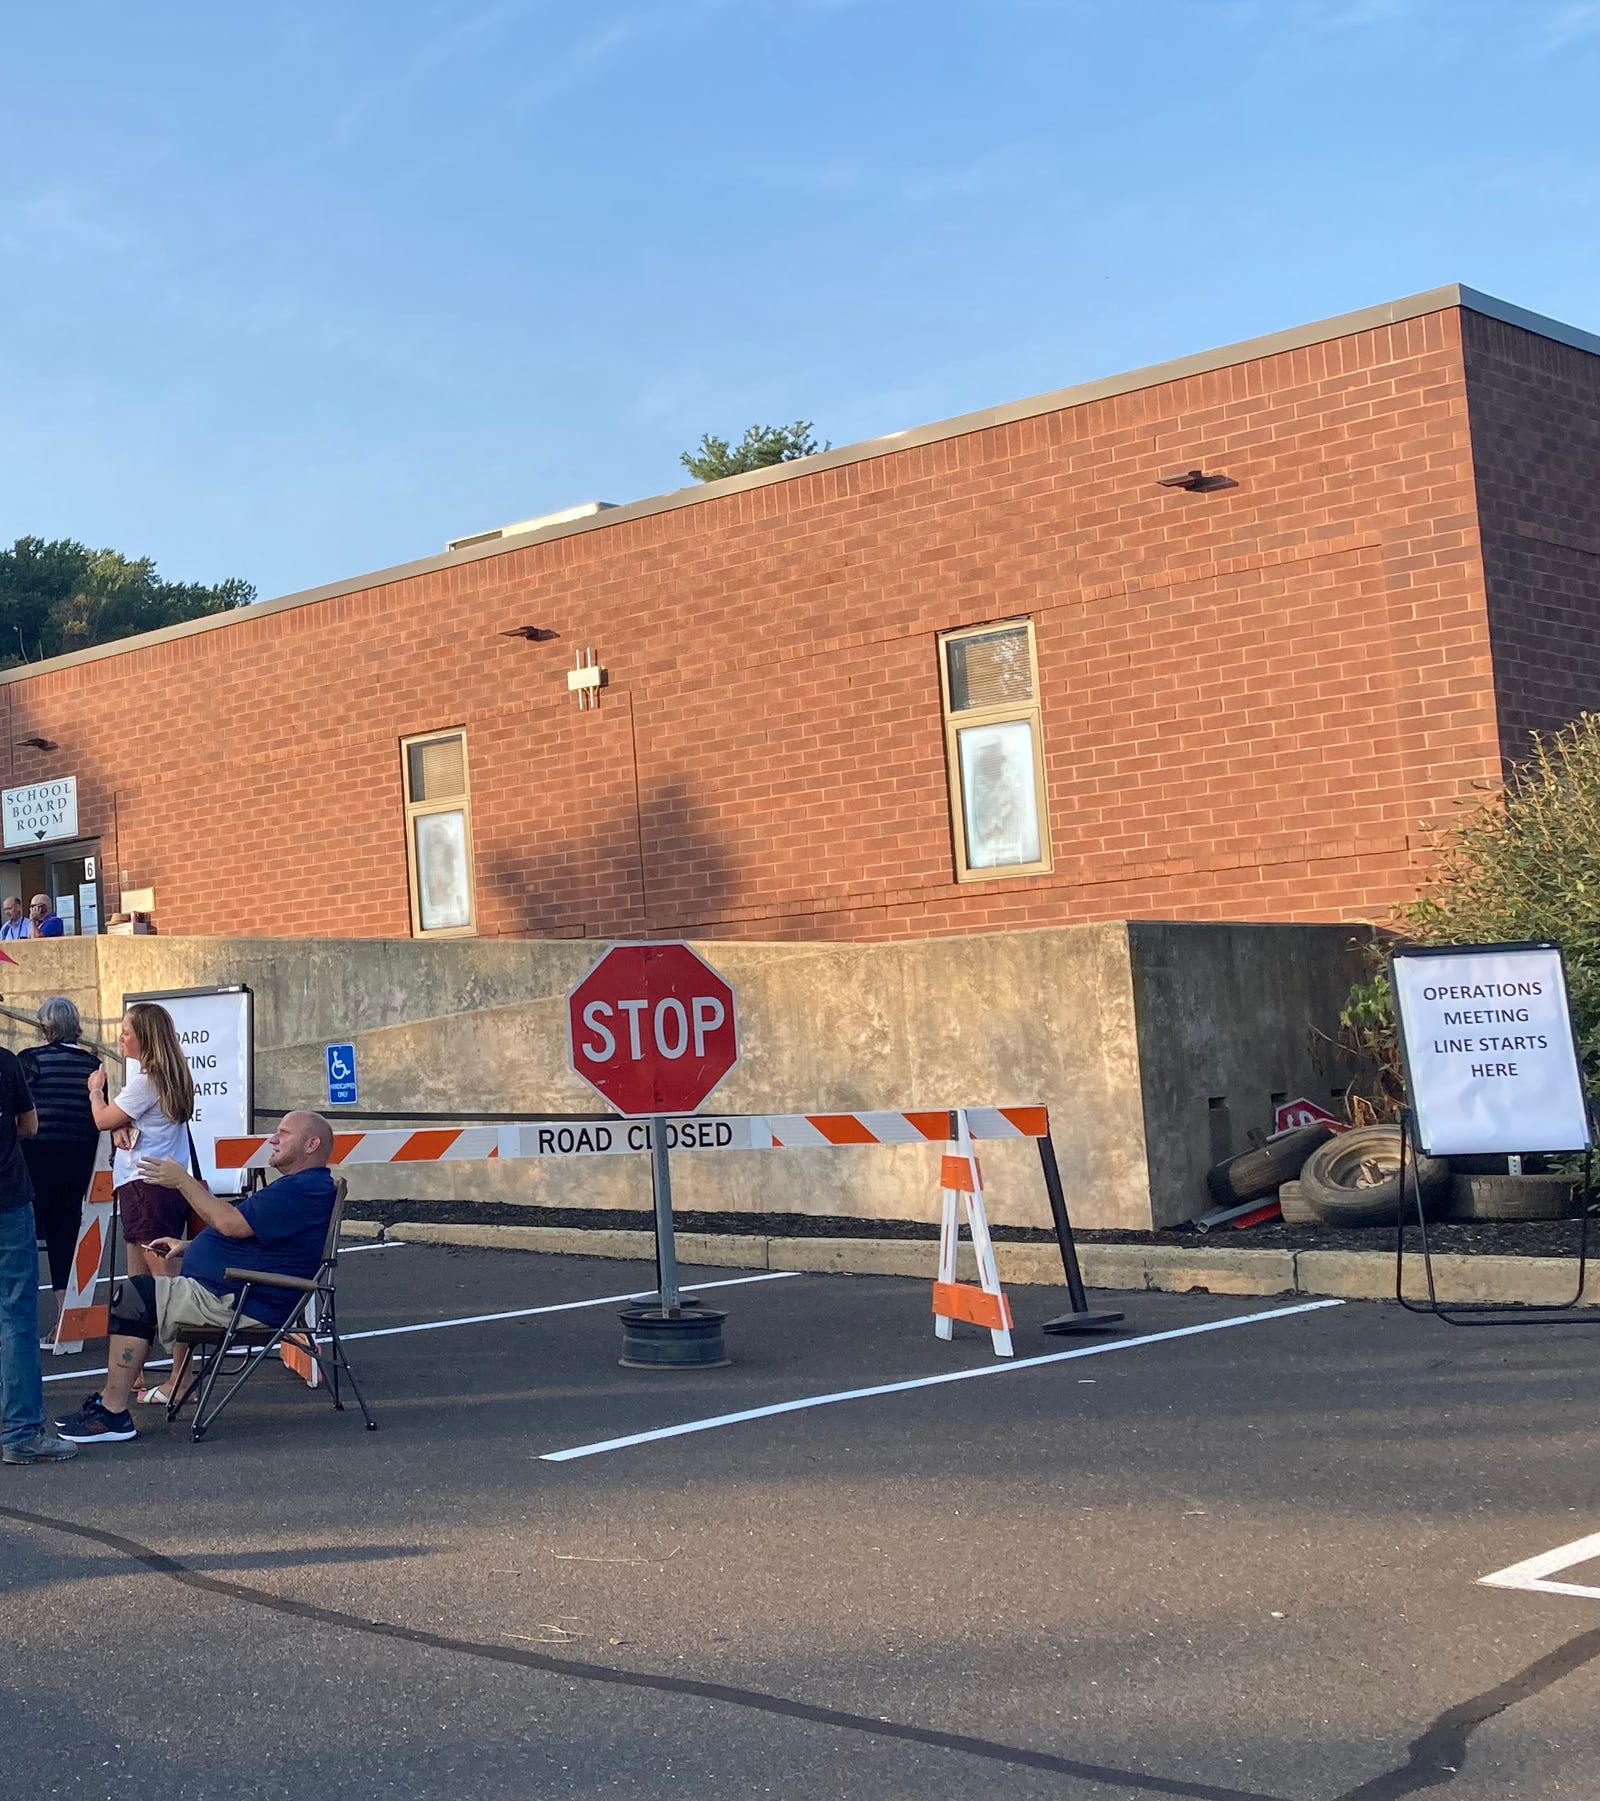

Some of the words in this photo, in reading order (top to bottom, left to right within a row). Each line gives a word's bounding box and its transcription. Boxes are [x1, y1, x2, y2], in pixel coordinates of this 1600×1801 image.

[6, 783, 72, 806] SCHOOL
[12, 797, 67, 818] BOARD
[16, 812, 63, 832] ROOM
[86, 862, 94, 878] 6
[1423, 981, 1542, 1001] OPERATIONS
[1444, 1008, 1529, 1026] MEETING
[175, 1030, 210, 1044] ARD
[581, 996, 725, 1063] STOP
[1434, 1038, 1474, 1054] LINE
[1479, 1035, 1548, 1051] STARTS
[1471, 1062, 1518, 1078] HERE
[193, 1081, 228, 1097] ARTS
[538, 1127, 613, 1154] ROAD
[627, 1122, 733, 1151] CLOSED
